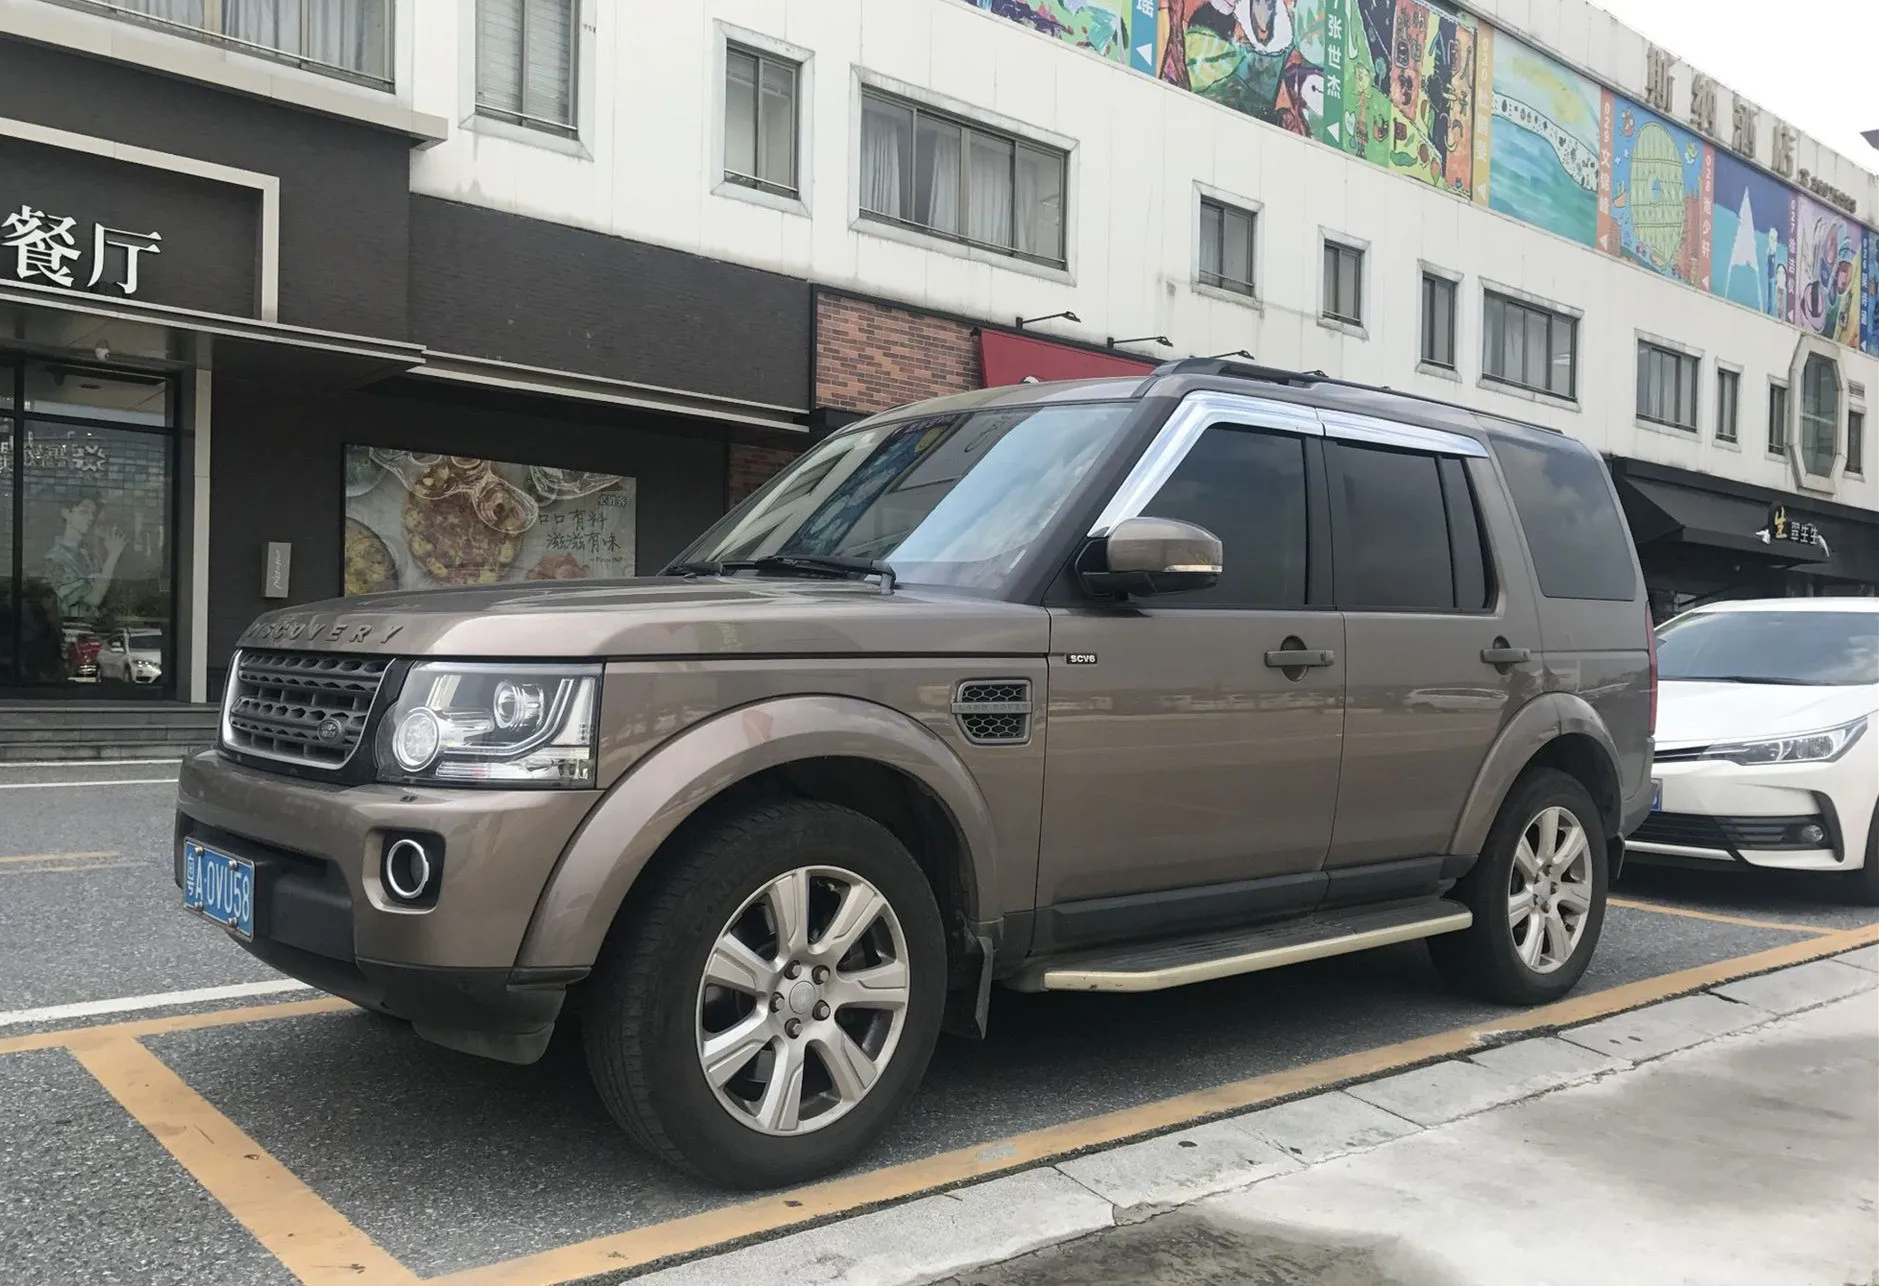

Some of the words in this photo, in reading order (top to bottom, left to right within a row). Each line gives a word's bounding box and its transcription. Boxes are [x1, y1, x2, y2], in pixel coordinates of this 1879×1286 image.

[1327, 14, 1342, 99] 张世杰
[1, 203, 162, 295] 餐厅
[538, 509, 608, 530] 口口有料
[546, 532, 622, 553] 滋滋有味
[1791, 521, 1819, 545] 翠生生
[246, 622, 404, 645] DISCOVERY
[1070, 654, 1096, 664] SCV6
